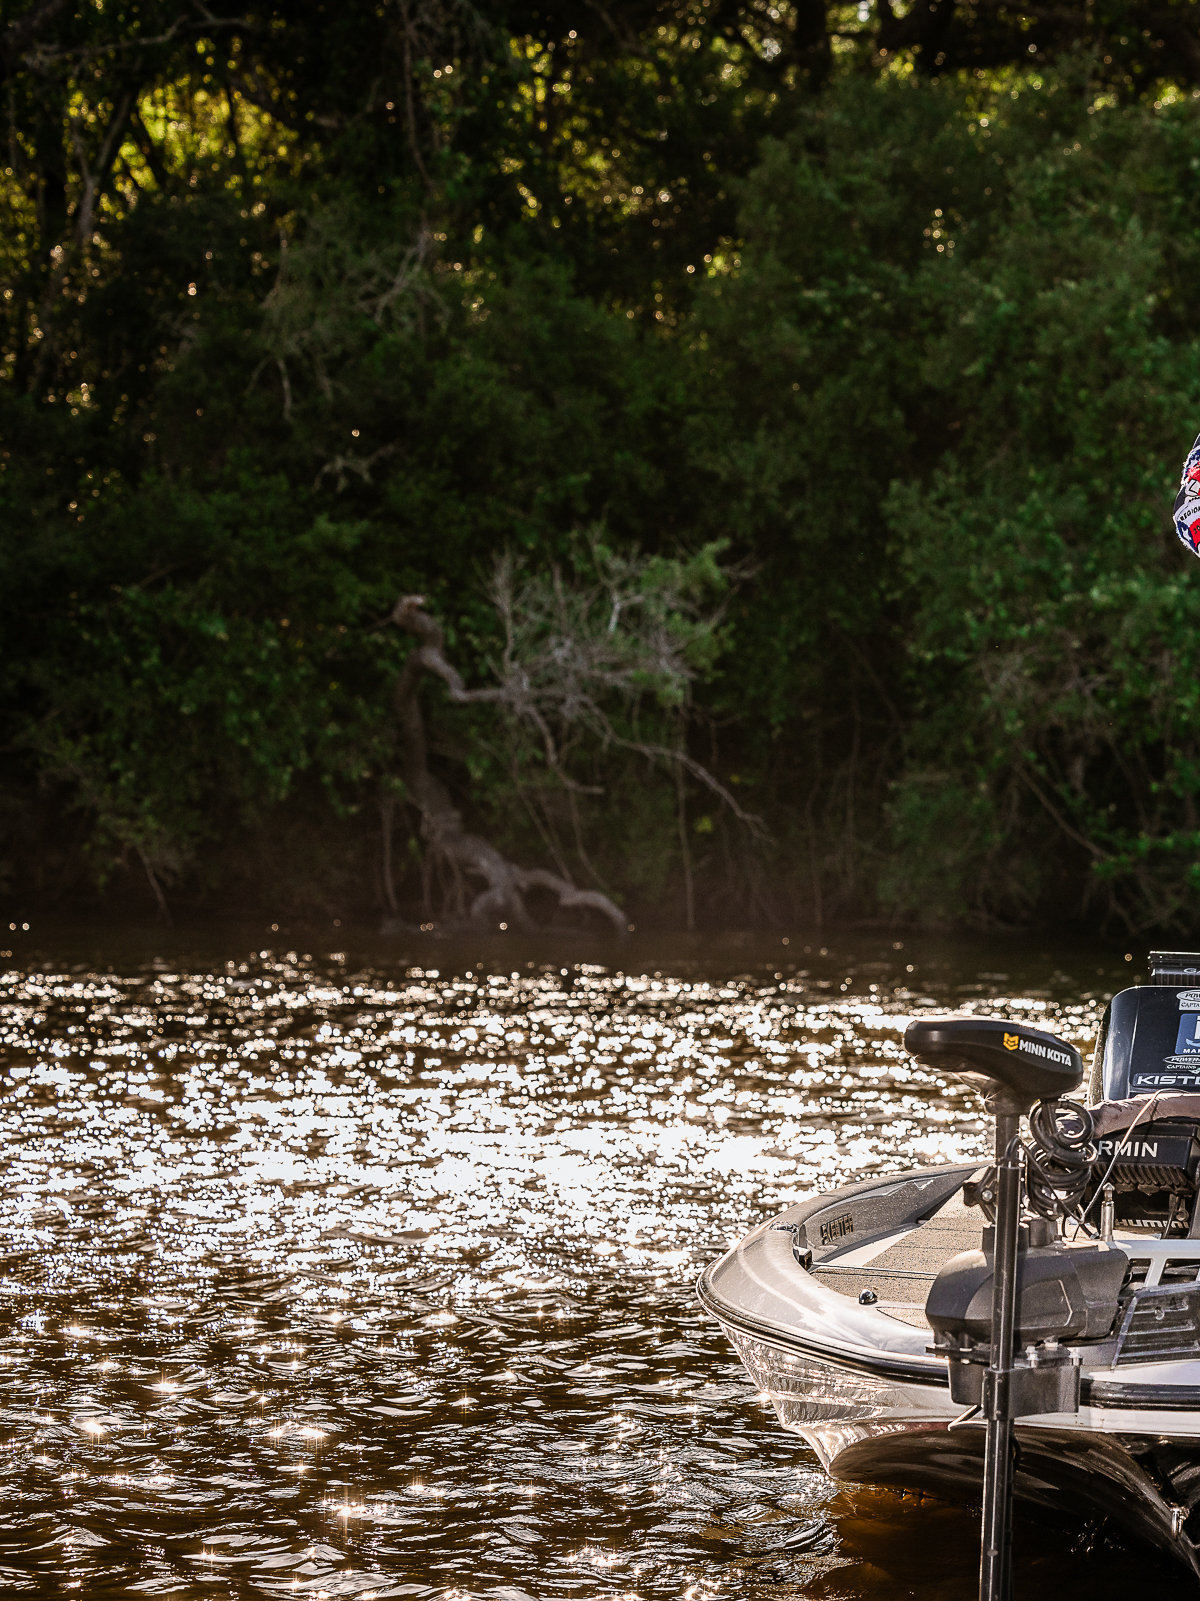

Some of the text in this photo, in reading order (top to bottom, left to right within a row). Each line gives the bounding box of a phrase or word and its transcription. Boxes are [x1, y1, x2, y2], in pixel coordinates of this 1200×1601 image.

[1019, 1039, 1072, 1067] MINN KOTA
[1098, 1140, 1158, 1158] RMIN
